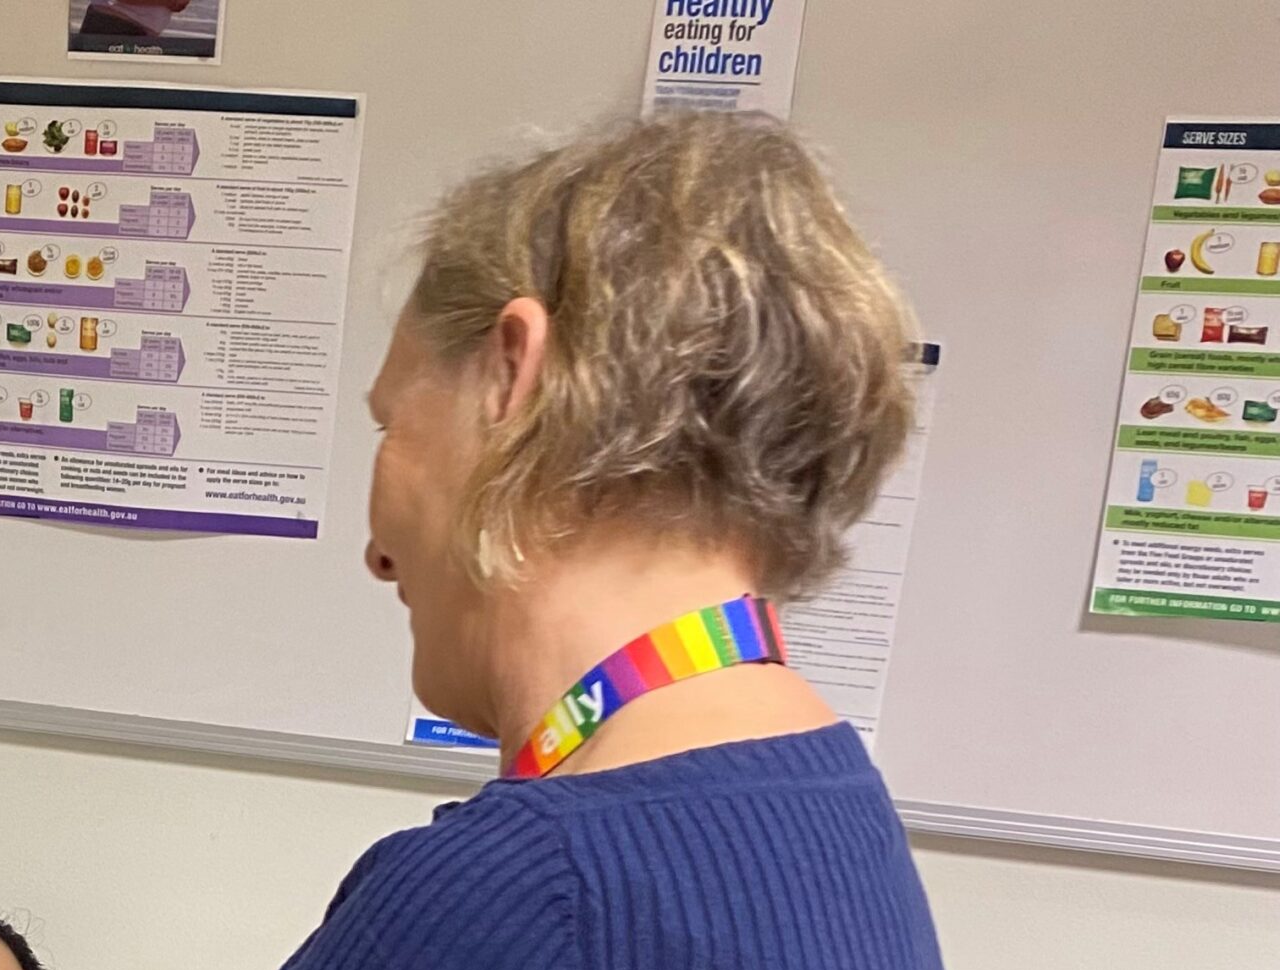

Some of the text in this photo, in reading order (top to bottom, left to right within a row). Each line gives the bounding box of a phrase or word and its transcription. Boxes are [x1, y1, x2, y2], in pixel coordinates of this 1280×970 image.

[666, 0, 774, 25] Healthy
[664, 19, 756, 45] eating for
[108, 44, 123, 52] eat
[134, 44, 163, 54] health
[659, 45, 762, 75] children
[1182, 131, 1247, 145] SERVE SIZES
[1174, 211, 1220, 219] Vegetables
[205, 491, 306, 504] www.eatforhealth.gov.au
[17, 502, 26, 510] GO
[37, 504, 138, 520] www.eatforhealth.gov.au
[1187, 522, 1199, 530] fat
[1110, 595, 1127, 603] FOR
[1129, 596, 1167, 606] FURTHER
[1169, 599, 1228, 611] INFORMATION
[1229, 604, 1242, 612] GO
[1245, 605, 1256, 613] TO
[539, 680, 605, 754] ally
[432, 726, 447, 735] FOR
